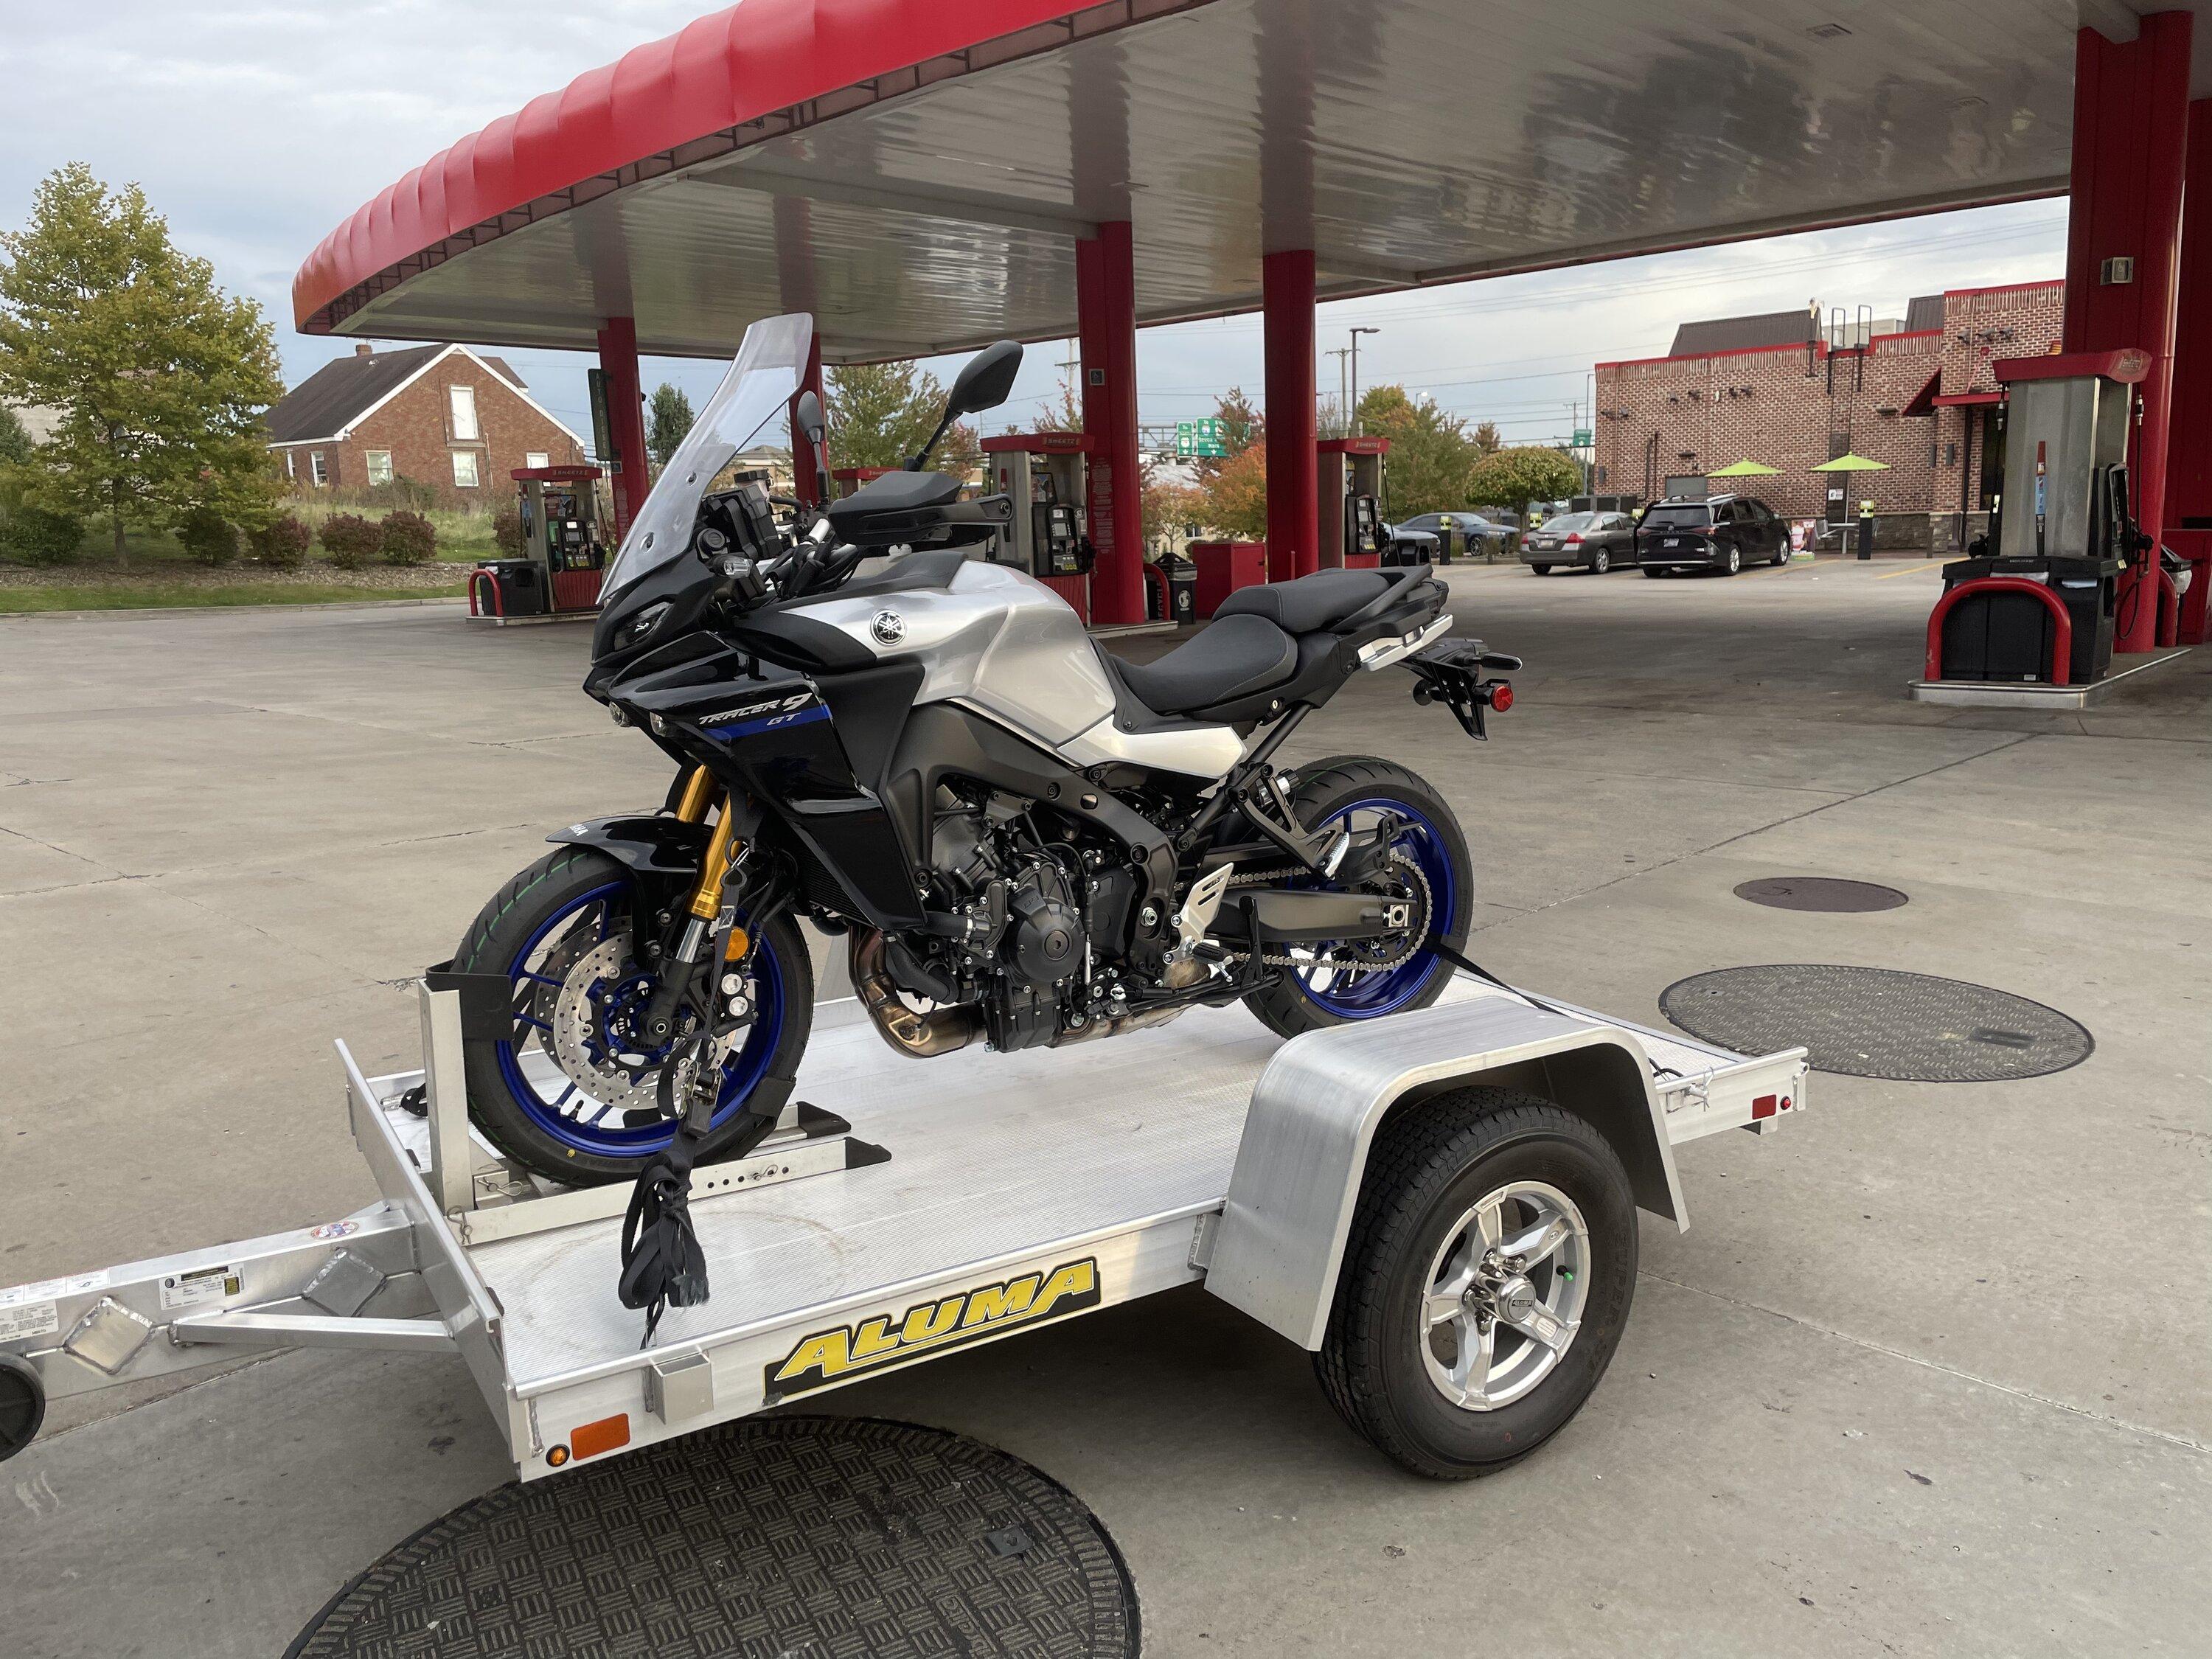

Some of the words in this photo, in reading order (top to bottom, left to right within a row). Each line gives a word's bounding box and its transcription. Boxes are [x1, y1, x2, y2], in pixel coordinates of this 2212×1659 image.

[595, 373, 603, 403] AUTO
[698, 699, 781, 725] TRACER
[782, 692, 813, 712] 9
[766, 712, 801, 726] GT
[773, 1260, 1095, 1382] ALUMA
